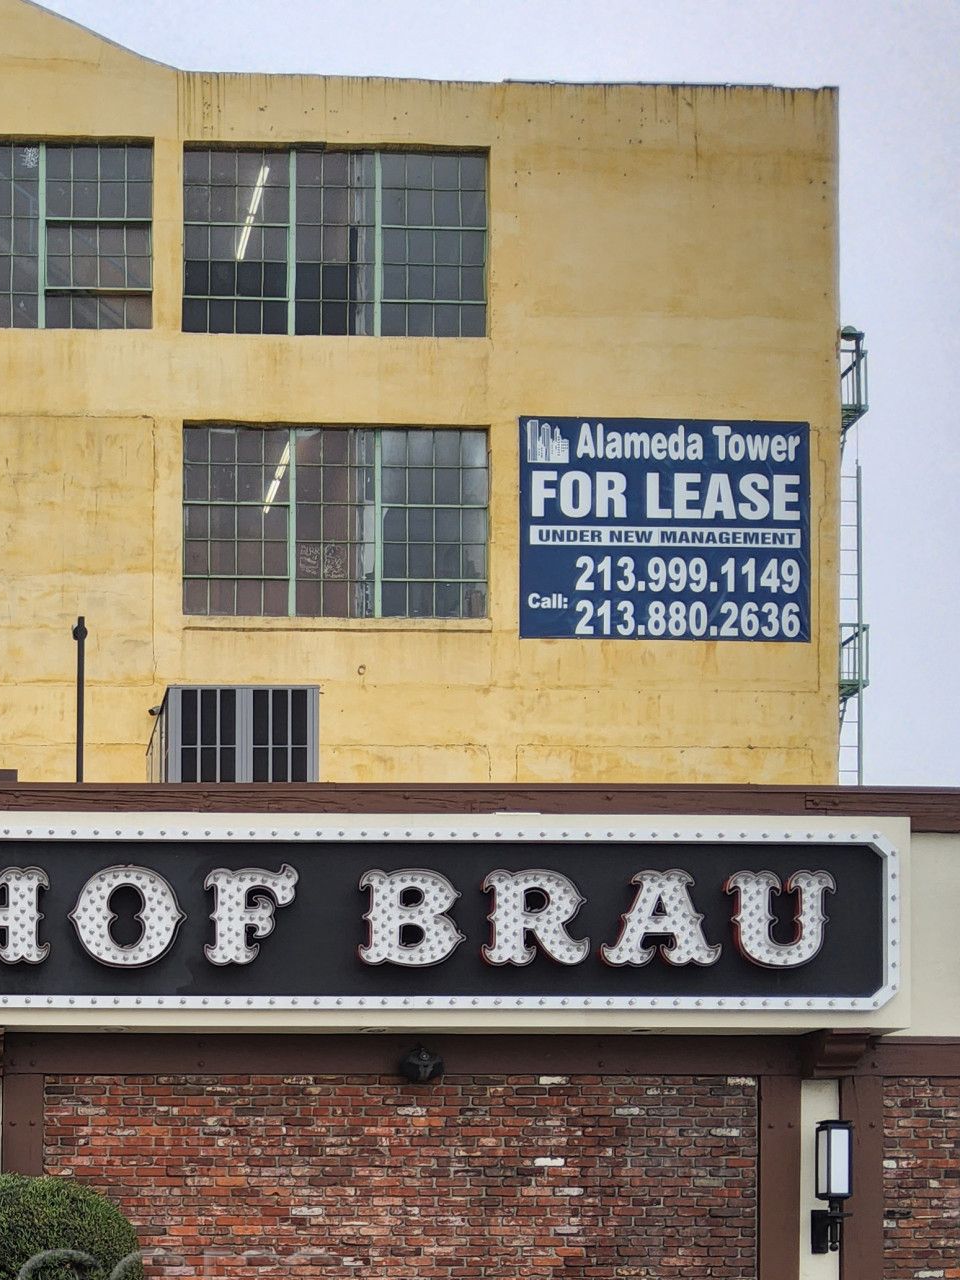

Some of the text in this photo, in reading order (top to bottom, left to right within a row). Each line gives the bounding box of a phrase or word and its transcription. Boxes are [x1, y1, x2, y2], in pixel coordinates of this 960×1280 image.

[576, 422, 801, 463] Alameda Tower
[531, 471, 801, 520] FOR LEASE
[538, 529, 797, 546] UNDER NEW MANAGEMENT
[575, 556, 801, 593] 213.999.1149
[527, 592, 569, 610] Call:
[575, 600, 801, 637] 213.880.2636
[357, 867, 838, 971] BRAU
